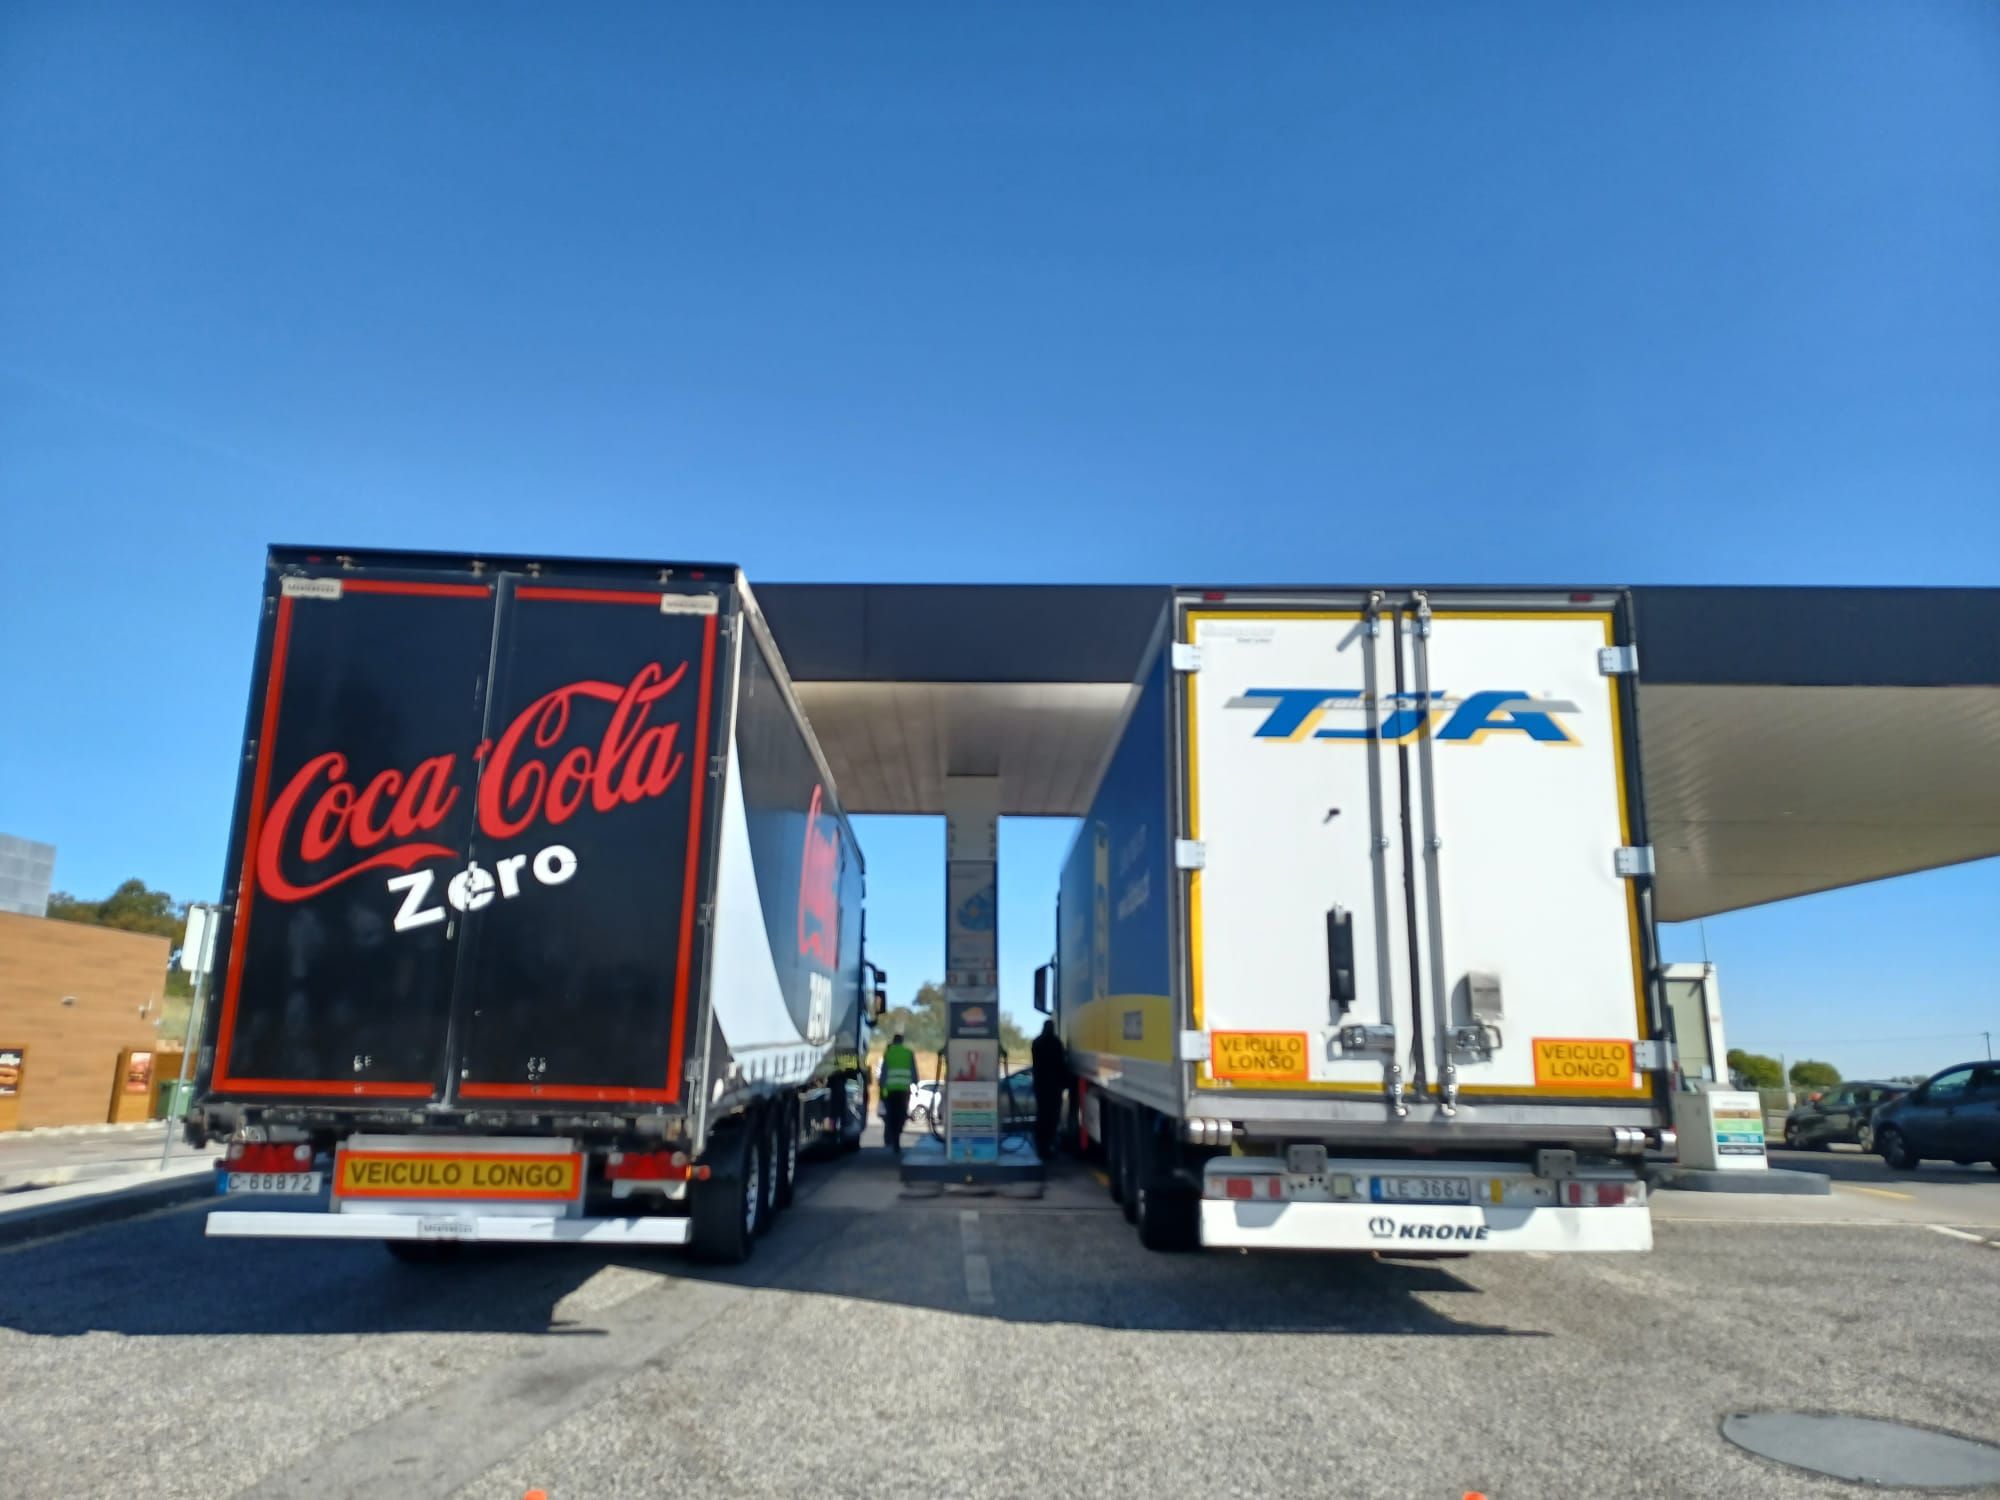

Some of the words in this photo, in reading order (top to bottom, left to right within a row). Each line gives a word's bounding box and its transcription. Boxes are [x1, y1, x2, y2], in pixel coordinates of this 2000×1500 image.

[1242, 687, 1576, 744] TJA
[1541, 1044, 1625, 1060] VEICULO
[1551, 1062, 1620, 1078] LONGO
[350, 1161, 462, 1185] VEICULO
[472, 1163, 565, 1187] LONGO
[1399, 1223, 1491, 1240] KRONE
